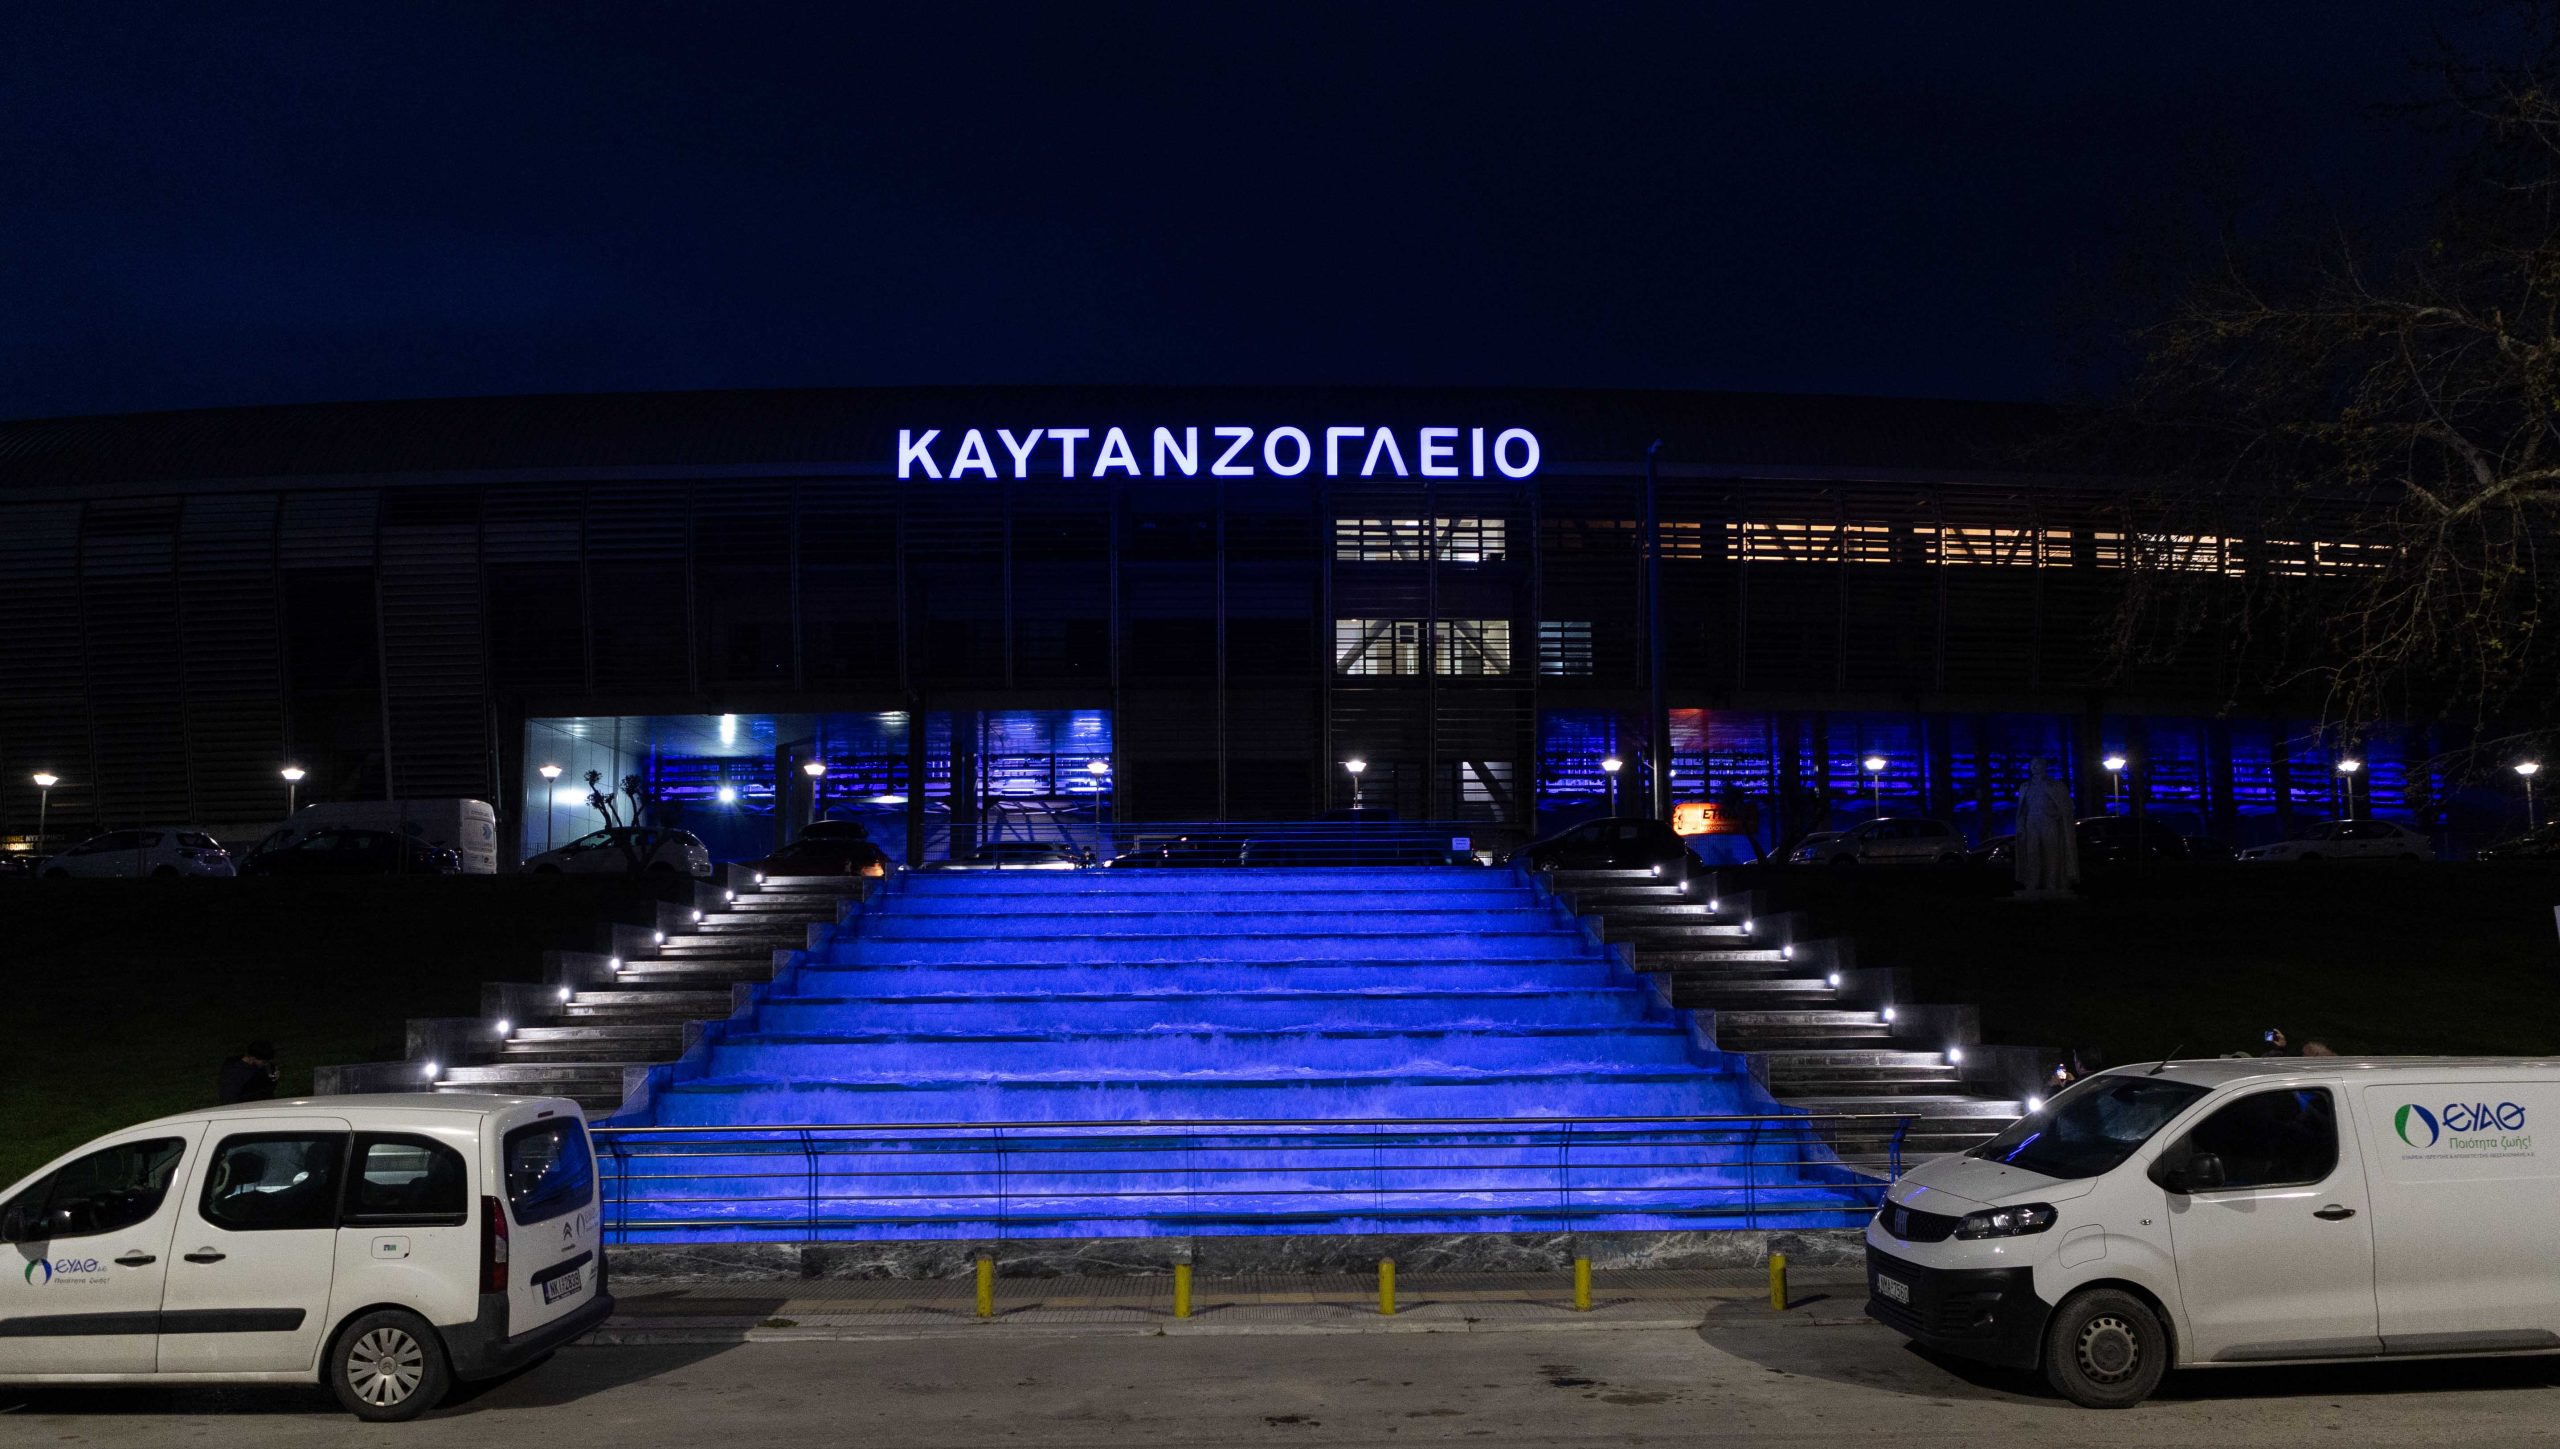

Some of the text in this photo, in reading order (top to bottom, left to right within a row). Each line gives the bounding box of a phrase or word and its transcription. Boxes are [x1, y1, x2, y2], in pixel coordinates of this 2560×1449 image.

[899, 427, 1539, 478] ΚΑΥΤΑΝΖΟΓΛΕΙΟ
[2442, 1102, 2526, 1132] ΕΥΑΘ
[2450, 1136, 2532, 1150] Ποιότητα ζωής!
[54, 1258, 99, 1273] ΕΥΑΘ
